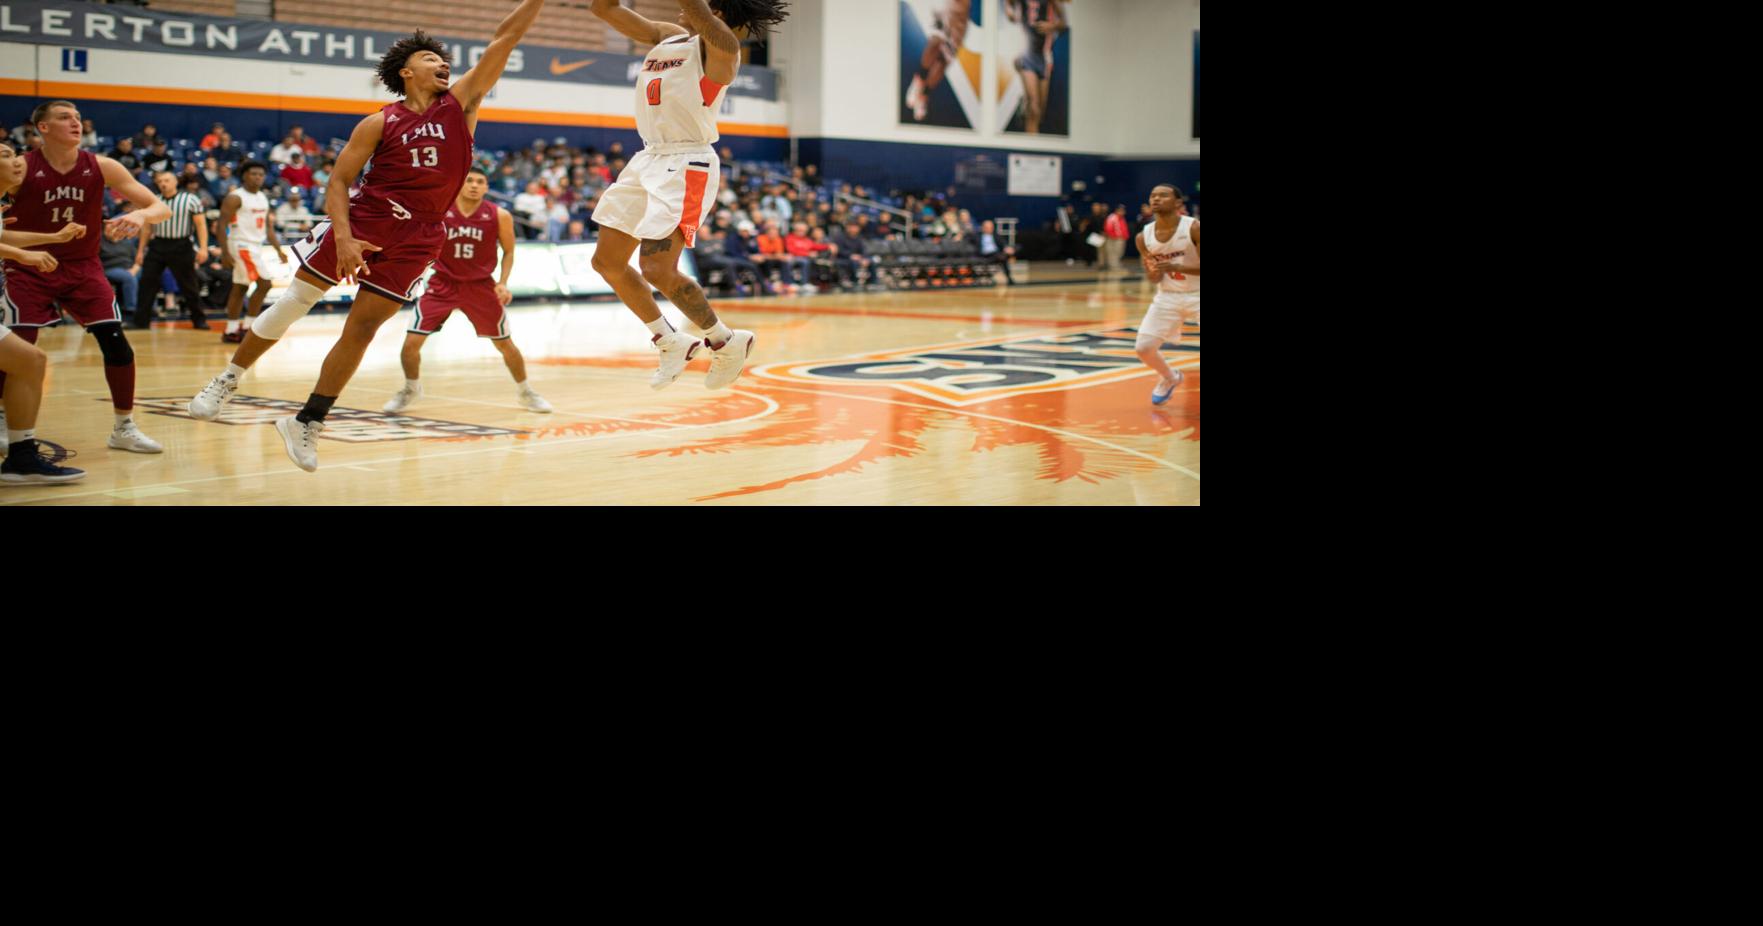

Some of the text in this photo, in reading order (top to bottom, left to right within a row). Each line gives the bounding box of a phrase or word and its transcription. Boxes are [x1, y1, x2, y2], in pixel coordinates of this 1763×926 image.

[1, 5, 524, 73] LERTON ATHLICS
[68, 50, 82, 71] L
[646, 77, 662, 105] 0
[409, 146, 439, 168] 13
[43, 185, 85, 204] LMU
[51, 206, 75, 222] 14
[447, 226, 483, 242] LMU
[454, 243, 474, 259] 15
